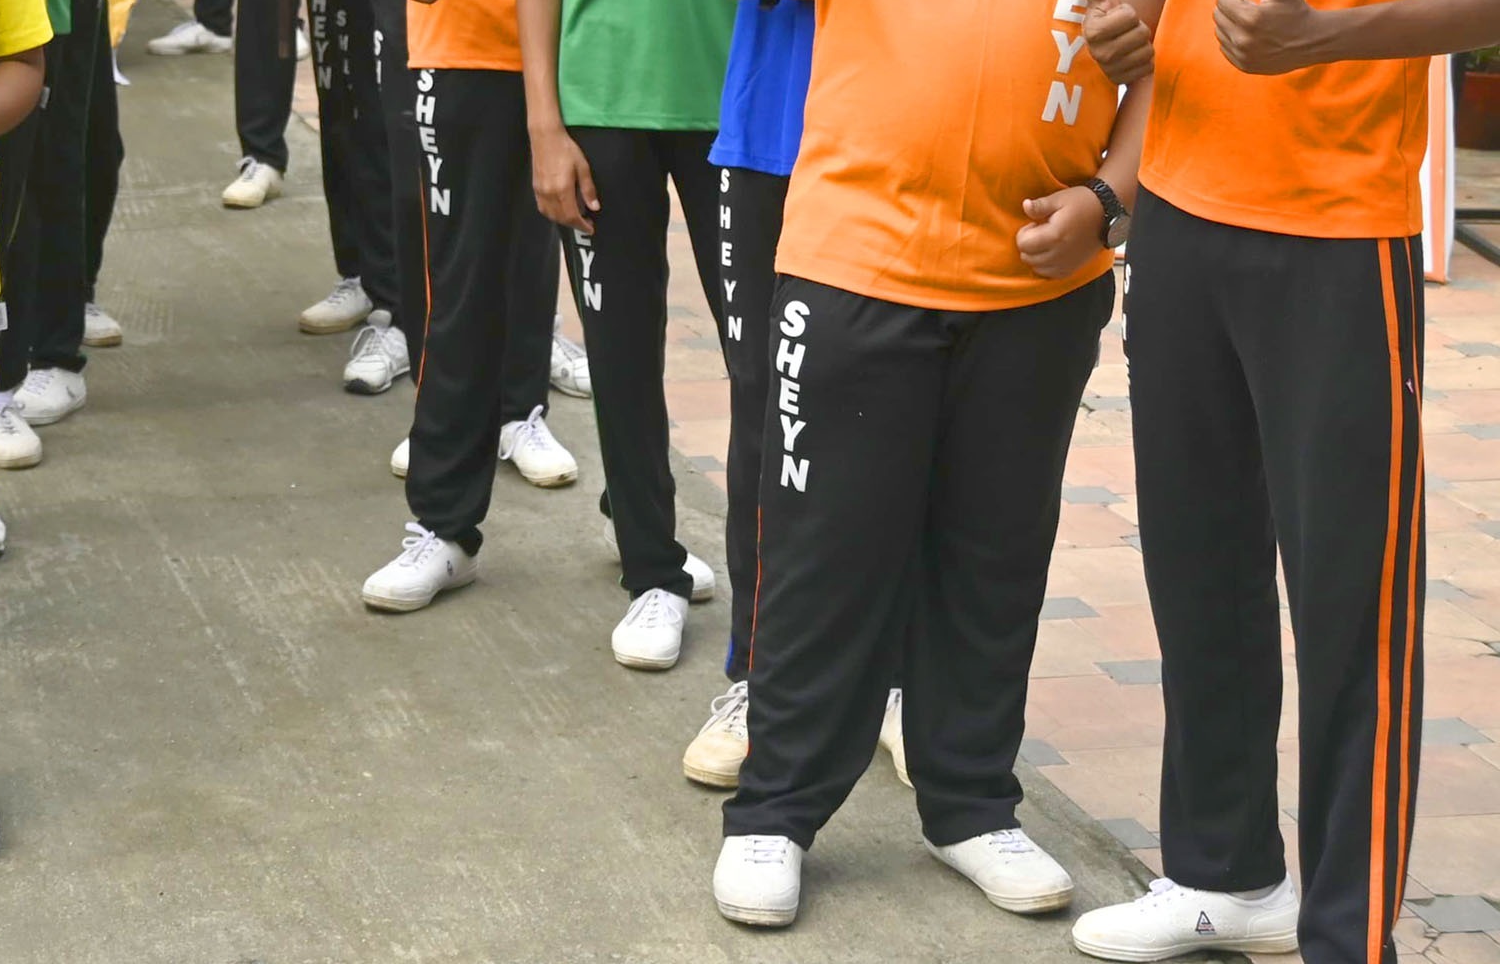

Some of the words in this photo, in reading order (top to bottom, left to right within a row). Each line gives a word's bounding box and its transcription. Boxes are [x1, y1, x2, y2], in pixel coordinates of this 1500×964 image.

[415, 67, 451, 217] SHEYN
[720, 168, 743, 341] SHEYN
[776, 300, 810, 492] SHEYN
